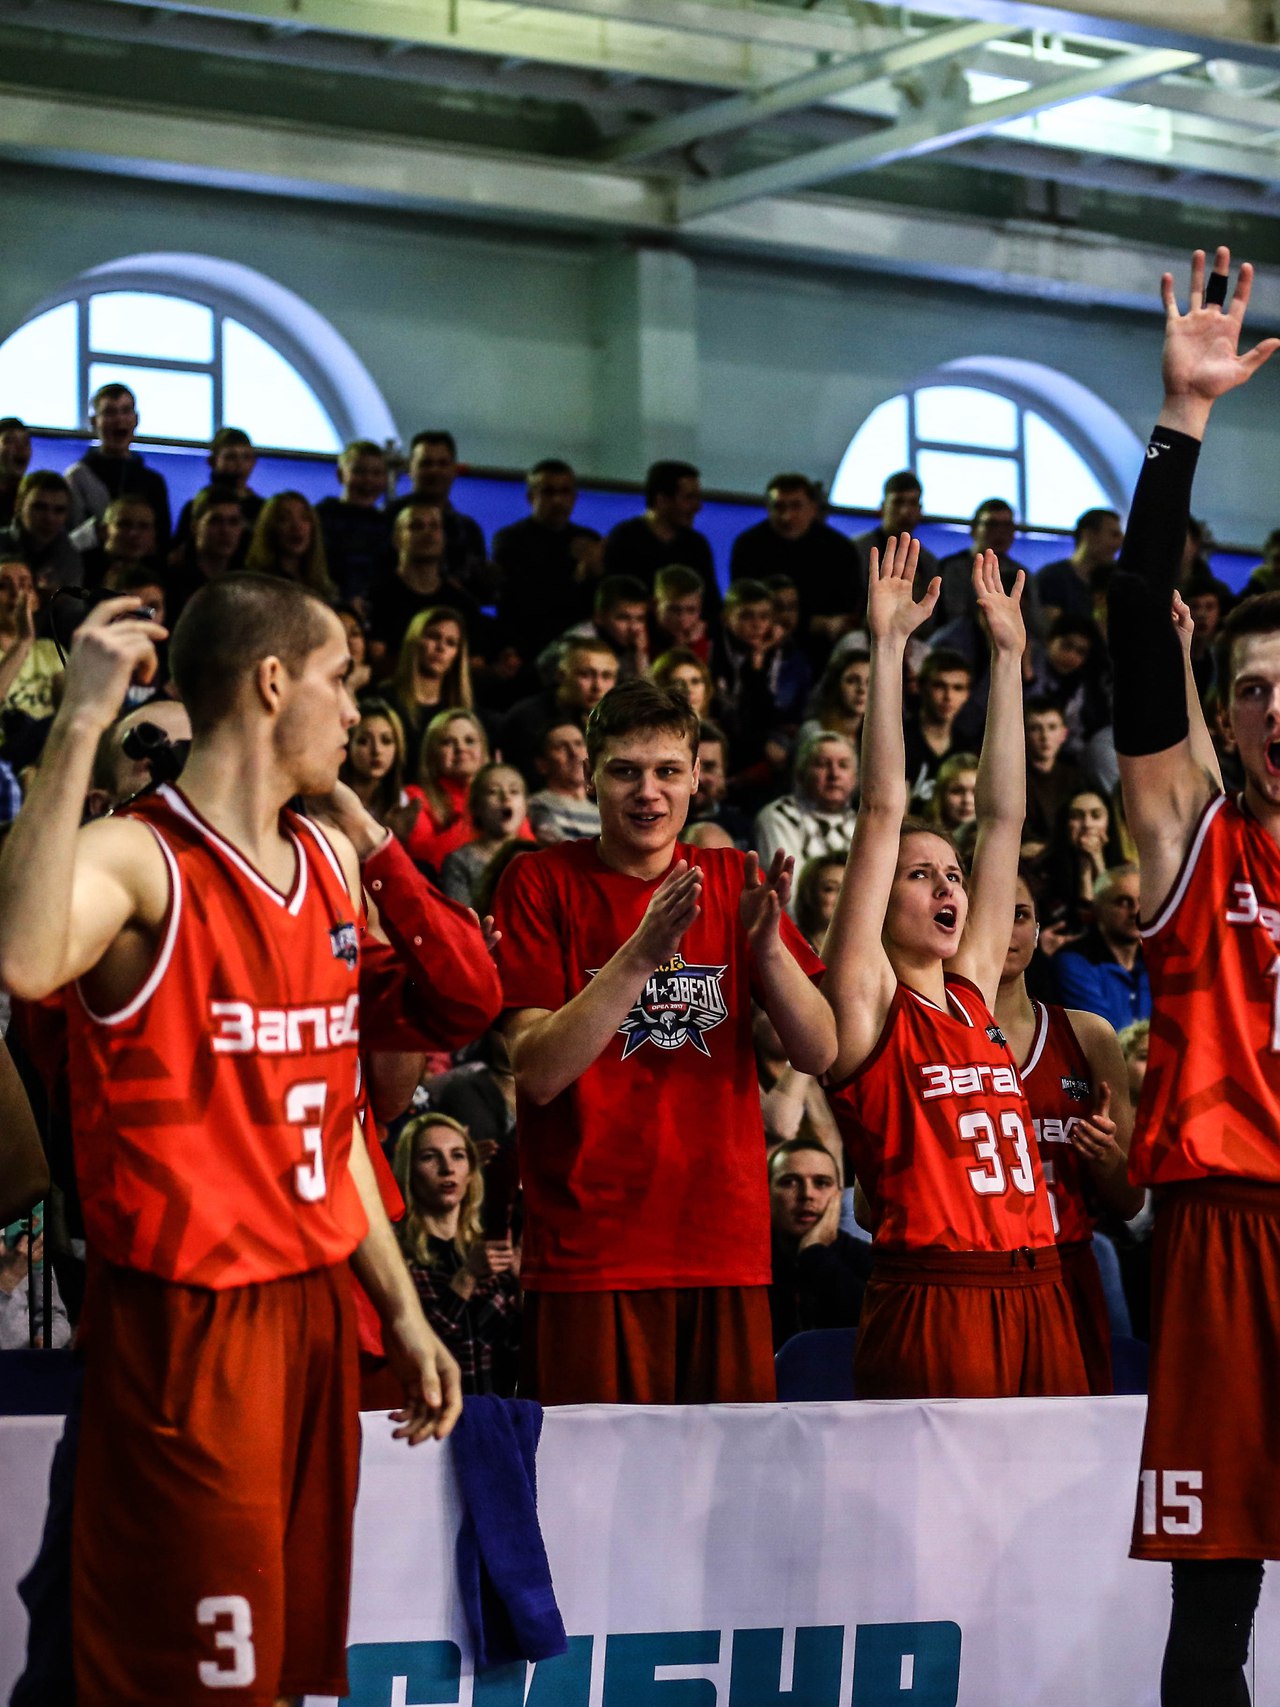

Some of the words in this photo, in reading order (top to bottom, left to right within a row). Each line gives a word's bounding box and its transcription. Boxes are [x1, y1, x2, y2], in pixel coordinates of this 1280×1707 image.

[286, 1082, 327, 1201] 3
[958, 1110, 1035, 1196] 33
[1140, 1469, 1203, 1535] 15
[197, 1595, 256, 1689] 3
